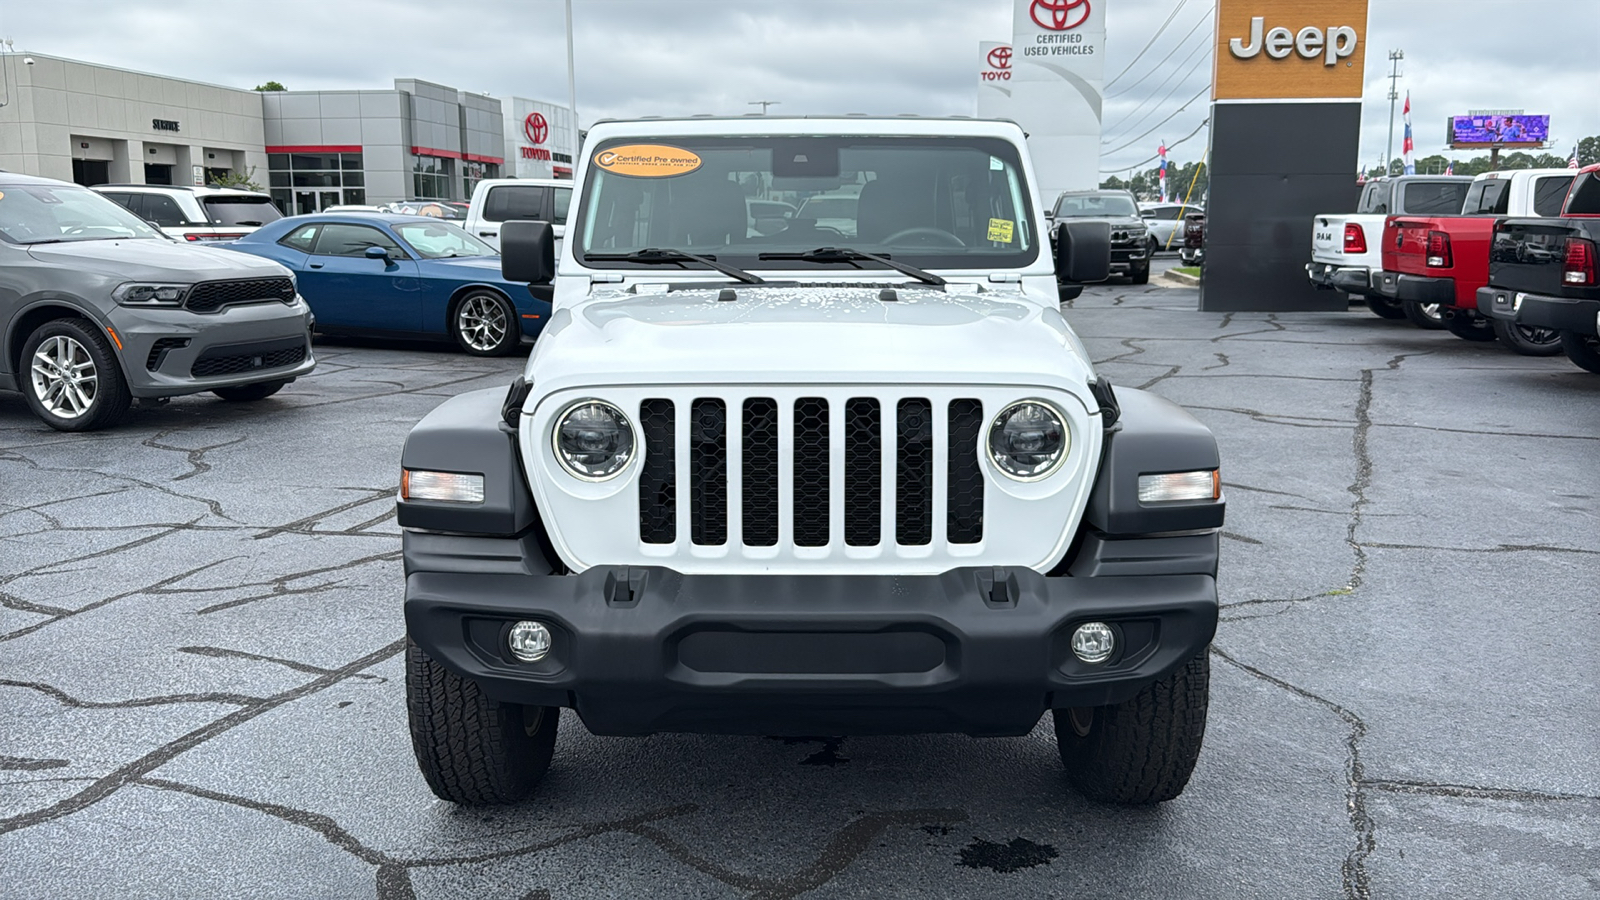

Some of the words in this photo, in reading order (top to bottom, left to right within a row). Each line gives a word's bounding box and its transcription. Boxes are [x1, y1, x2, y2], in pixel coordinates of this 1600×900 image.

[1036, 33, 1082, 44] CERTIFIED
[1229, 16, 1357, 67] Jeep
[1024, 47, 1048, 56] USED
[1051, 45, 1094, 55] VEHICLES
[980, 71, 1011, 81] TOYO
[520, 146, 551, 161] TOYOTA
[616, 155, 652, 163] Certified
